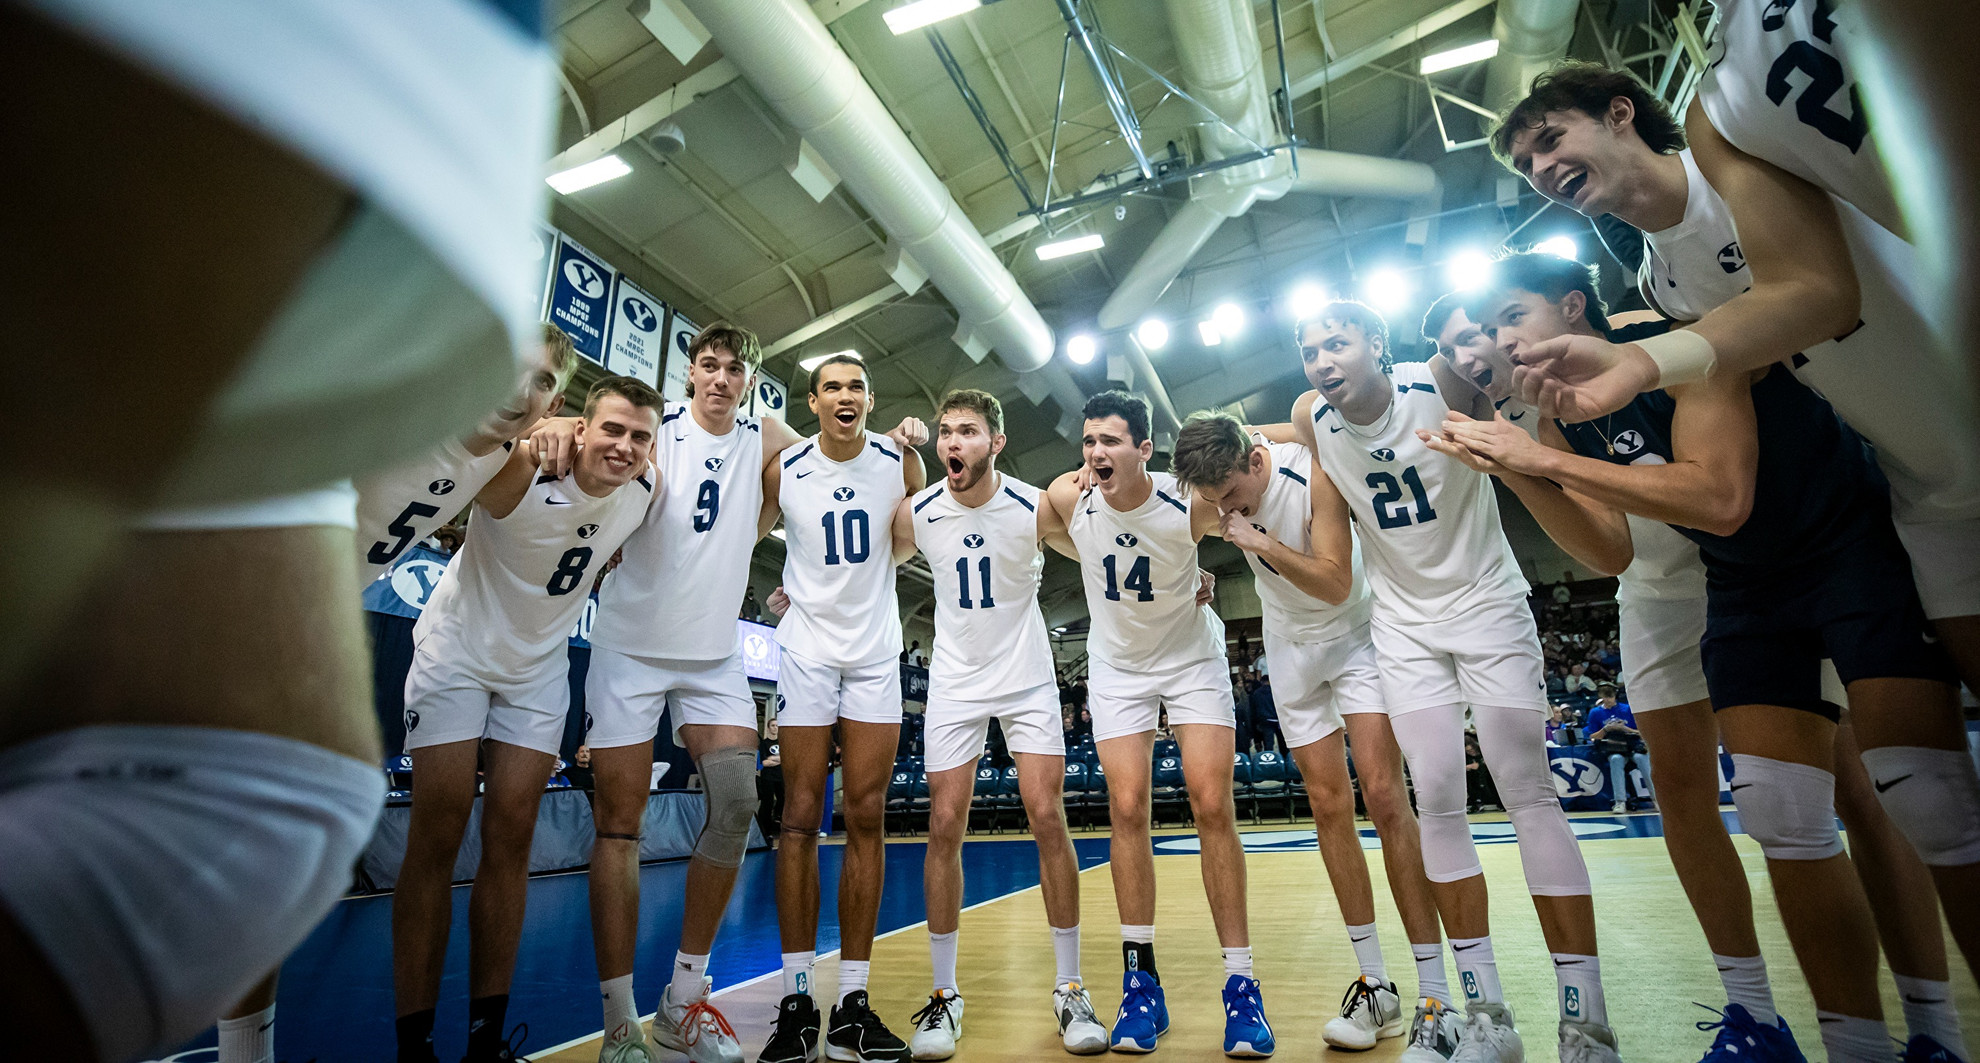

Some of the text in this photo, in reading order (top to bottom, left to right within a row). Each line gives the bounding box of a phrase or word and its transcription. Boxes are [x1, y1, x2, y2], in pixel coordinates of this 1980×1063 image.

[1766, 0, 1869, 155] 2
[572, 263, 599, 293] Y
[555, 307, 599, 339] CHAMPIONS
[629, 300, 653, 329] Y
[615, 343, 653, 370] CHAMPIONS
[629, 332, 644, 346] 2021
[762, 384, 779, 408] Y
[1615, 431, 1640, 452] Y
[693, 479, 720, 533] 9
[1365, 465, 1437, 529] 21
[367, 501, 440, 565] 5
[821, 509, 870, 565] 10
[546, 546, 593, 596] 8
[956, 556, 996, 609] 11
[1103, 554, 1154, 602] 14
[1551, 762, 1589, 793] Y
